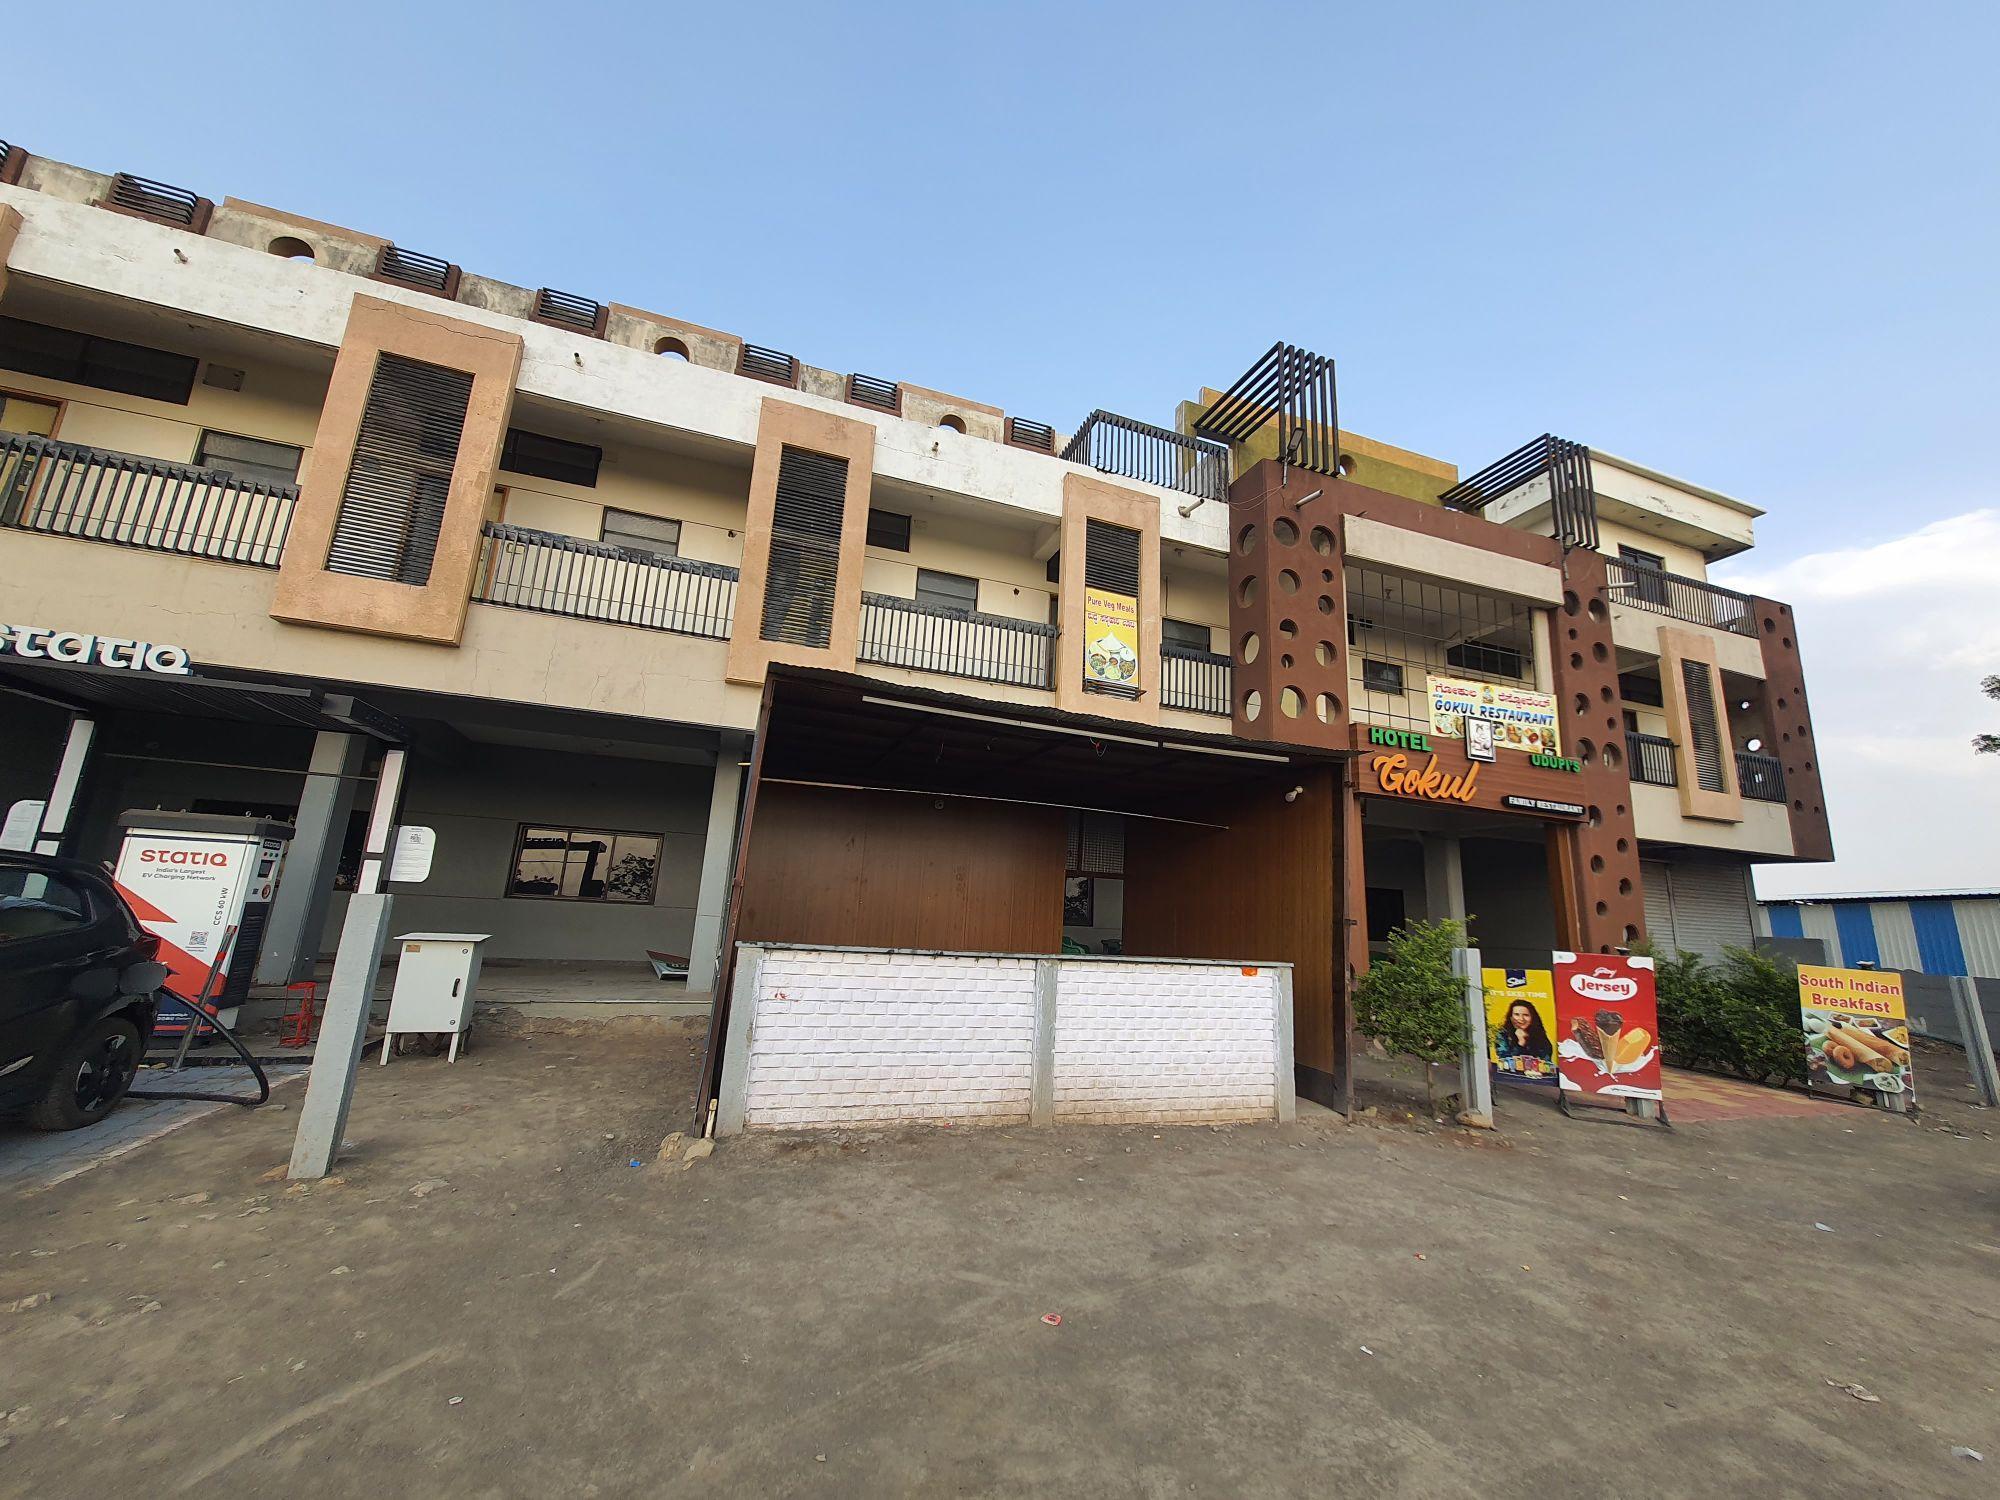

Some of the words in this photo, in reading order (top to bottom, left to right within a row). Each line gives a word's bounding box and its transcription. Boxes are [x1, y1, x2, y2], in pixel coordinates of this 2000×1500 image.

[1087, 595, 1102, 606] Pure
[1103, 599, 1115, 611] Veg
[1116, 602, 1135, 613] Meals
[1435, 699, 1476, 716] GOKUL
[1479, 705, 1554, 726] RESTAURANT
[1370, 727, 1433, 751] HOTEL
[1373, 754, 1480, 801] Gokul
[1577, 978, 1630, 996] Jersey
[1800, 973, 1844, 990] South
[1849, 978, 1900, 995] Indian
[1812, 993, 1890, 1013] Breakfast
